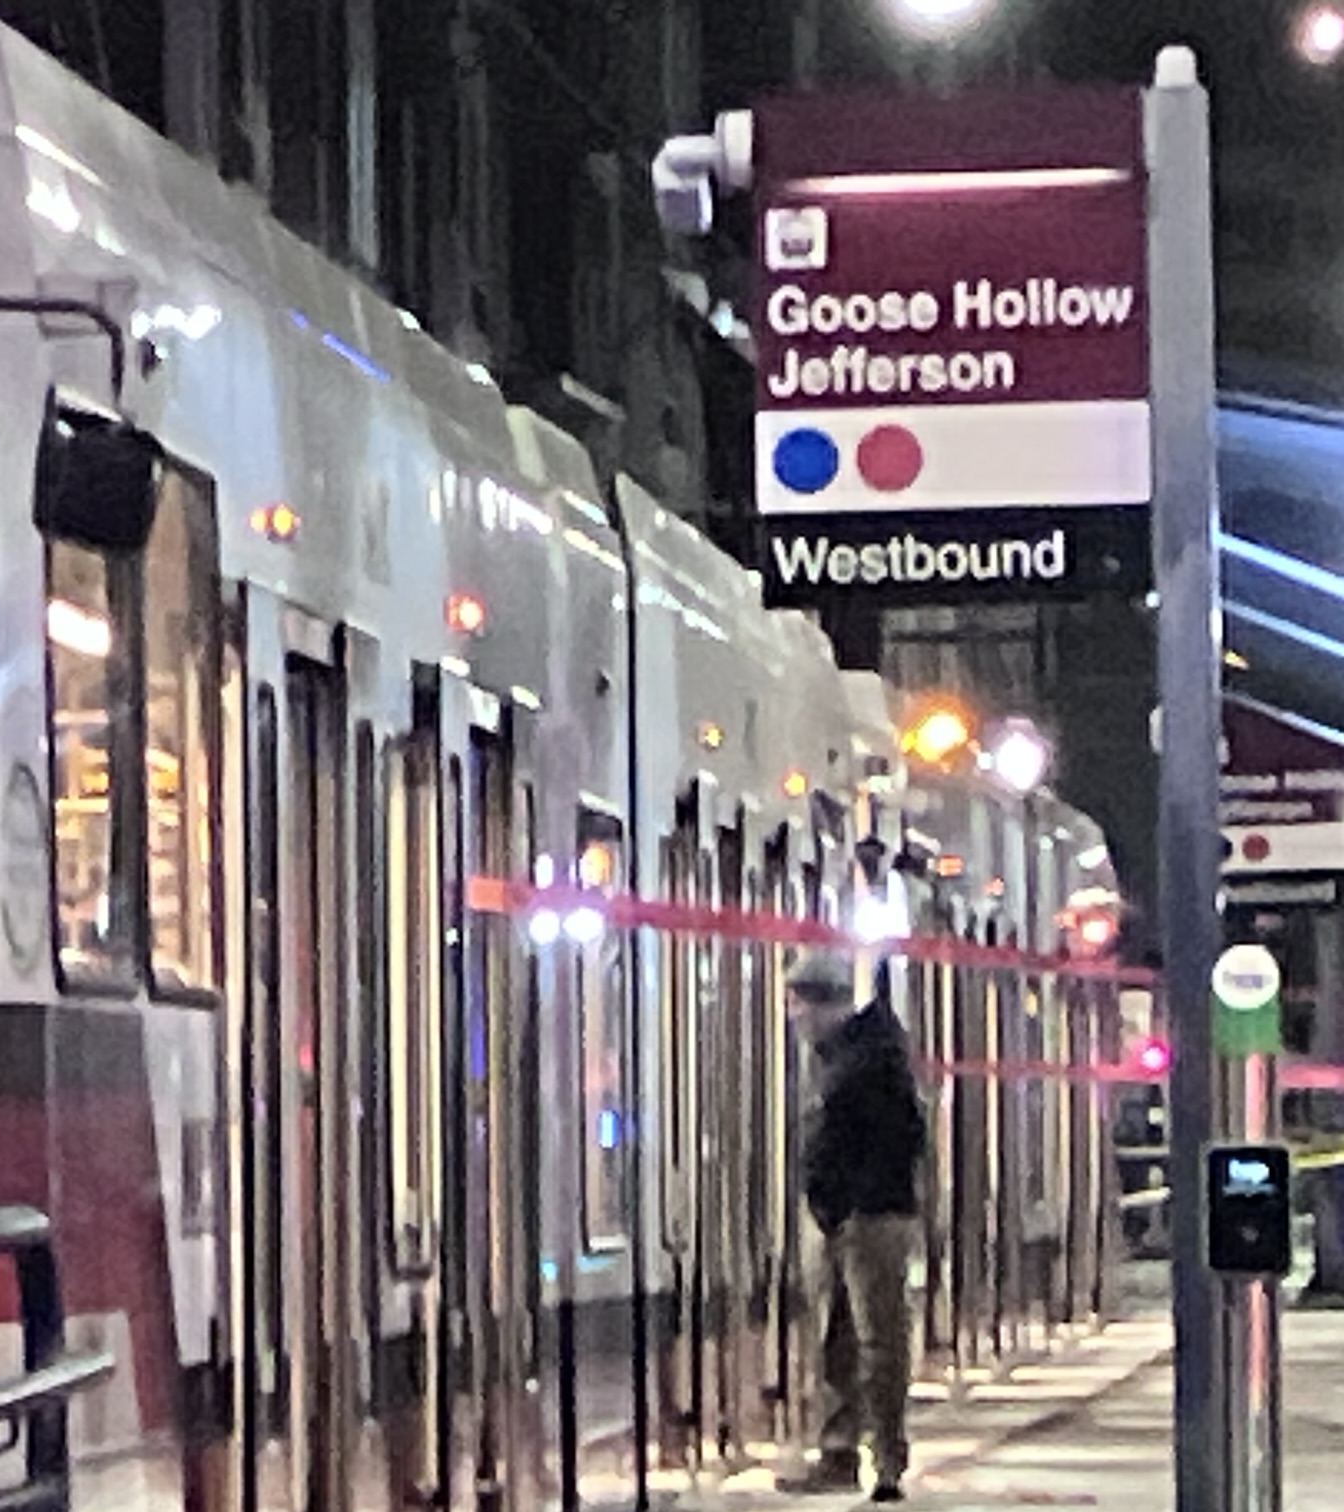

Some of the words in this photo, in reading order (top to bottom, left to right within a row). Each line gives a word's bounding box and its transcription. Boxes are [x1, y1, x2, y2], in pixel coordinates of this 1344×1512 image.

[766, 284, 940, 335] Goose
[953, 277, 1134, 330] Hollow
[767, 346, 1017, 397] Jefferson
[771, 529, 1067, 585] Westbound
